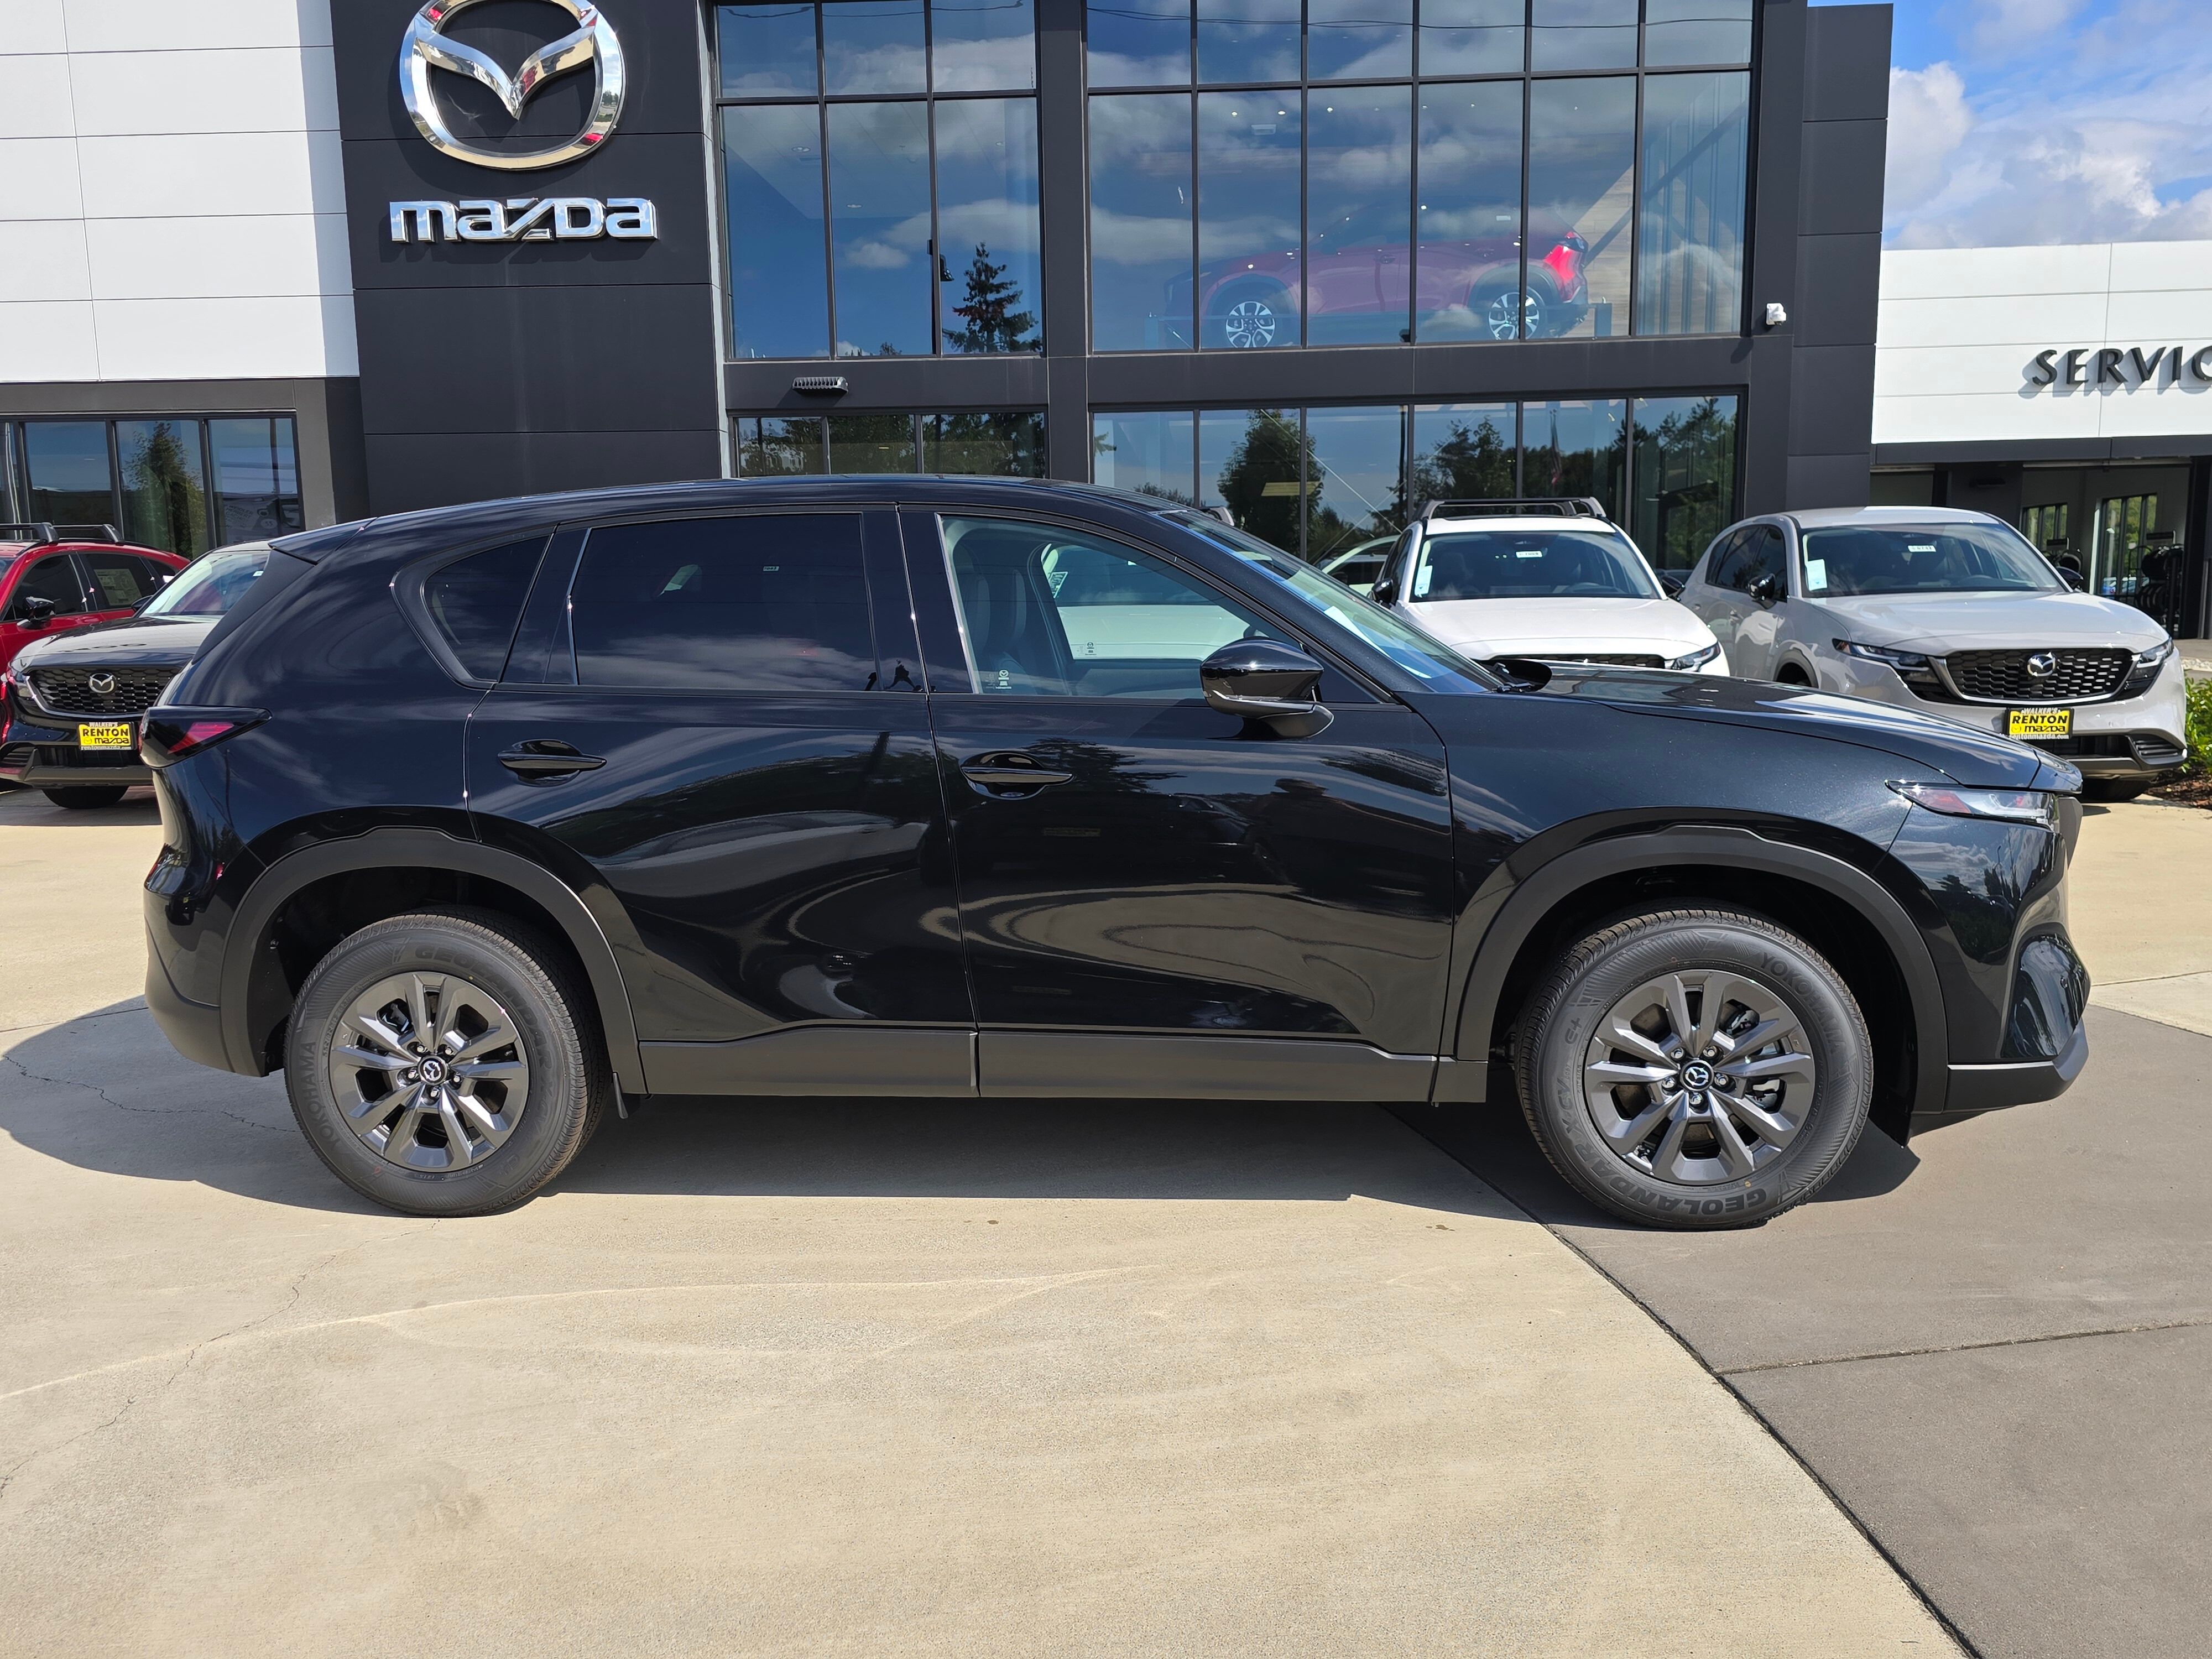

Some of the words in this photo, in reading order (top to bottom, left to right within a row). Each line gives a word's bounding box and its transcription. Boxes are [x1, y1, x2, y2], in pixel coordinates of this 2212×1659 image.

[82, 728, 128, 737] RENTON
[2012, 715, 2068, 724] RENTON
[1759, 953, 1845, 1053] YOKOHAMA
[299, 1041, 341, 1151] YOKOHAMA
[1574, 1141, 1767, 1215] GEOLANDAR
